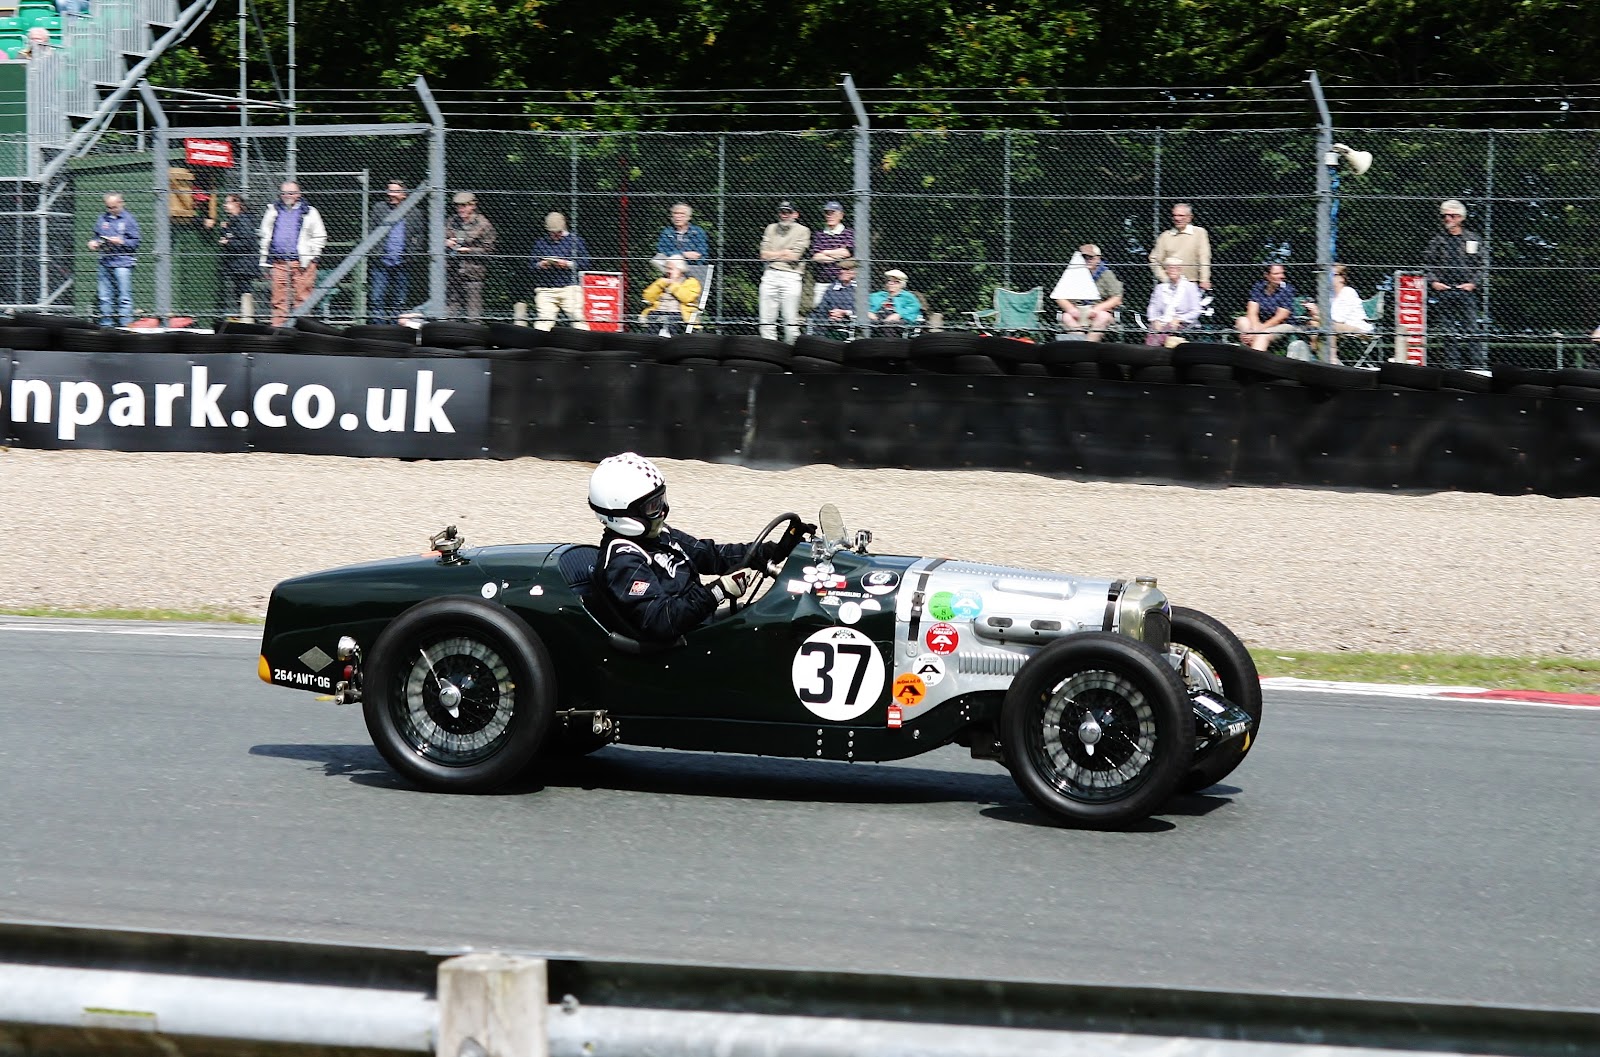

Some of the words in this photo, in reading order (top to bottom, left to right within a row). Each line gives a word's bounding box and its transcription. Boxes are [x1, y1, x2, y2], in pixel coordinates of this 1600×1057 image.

[0, 365, 456, 441] npark.co.uk
[799, 641, 871, 706] 37
[917, 664, 941, 674] A
